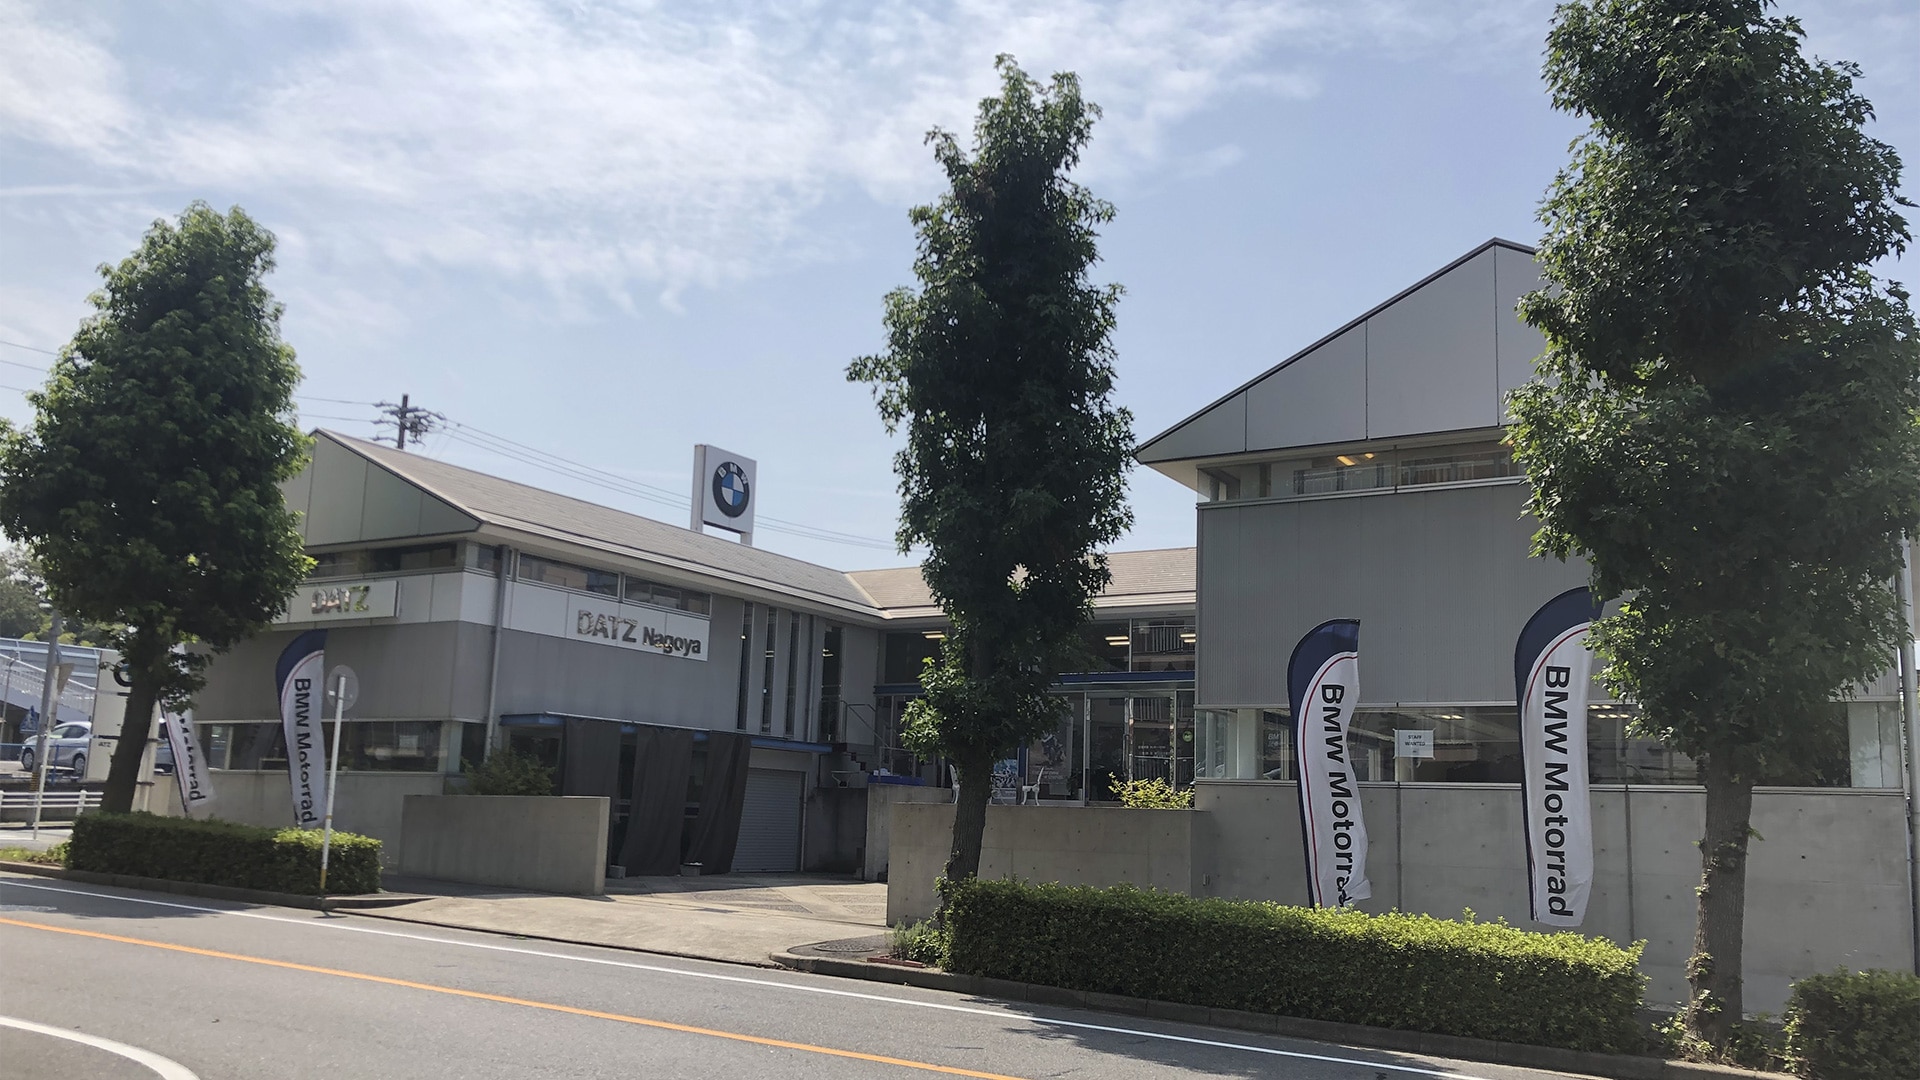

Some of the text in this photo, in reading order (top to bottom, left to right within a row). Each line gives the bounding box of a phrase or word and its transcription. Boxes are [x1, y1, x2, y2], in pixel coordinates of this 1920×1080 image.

[717, 463, 748, 484] BMW
[312, 585, 370, 614] DATZ
[577, 609, 702, 656] DATZ Nagoya
[294, 678, 317, 823] BMW Motorrad
[1321, 684, 1345, 763] BMW
[1544, 665, 1574, 917] BMW Motorrad
